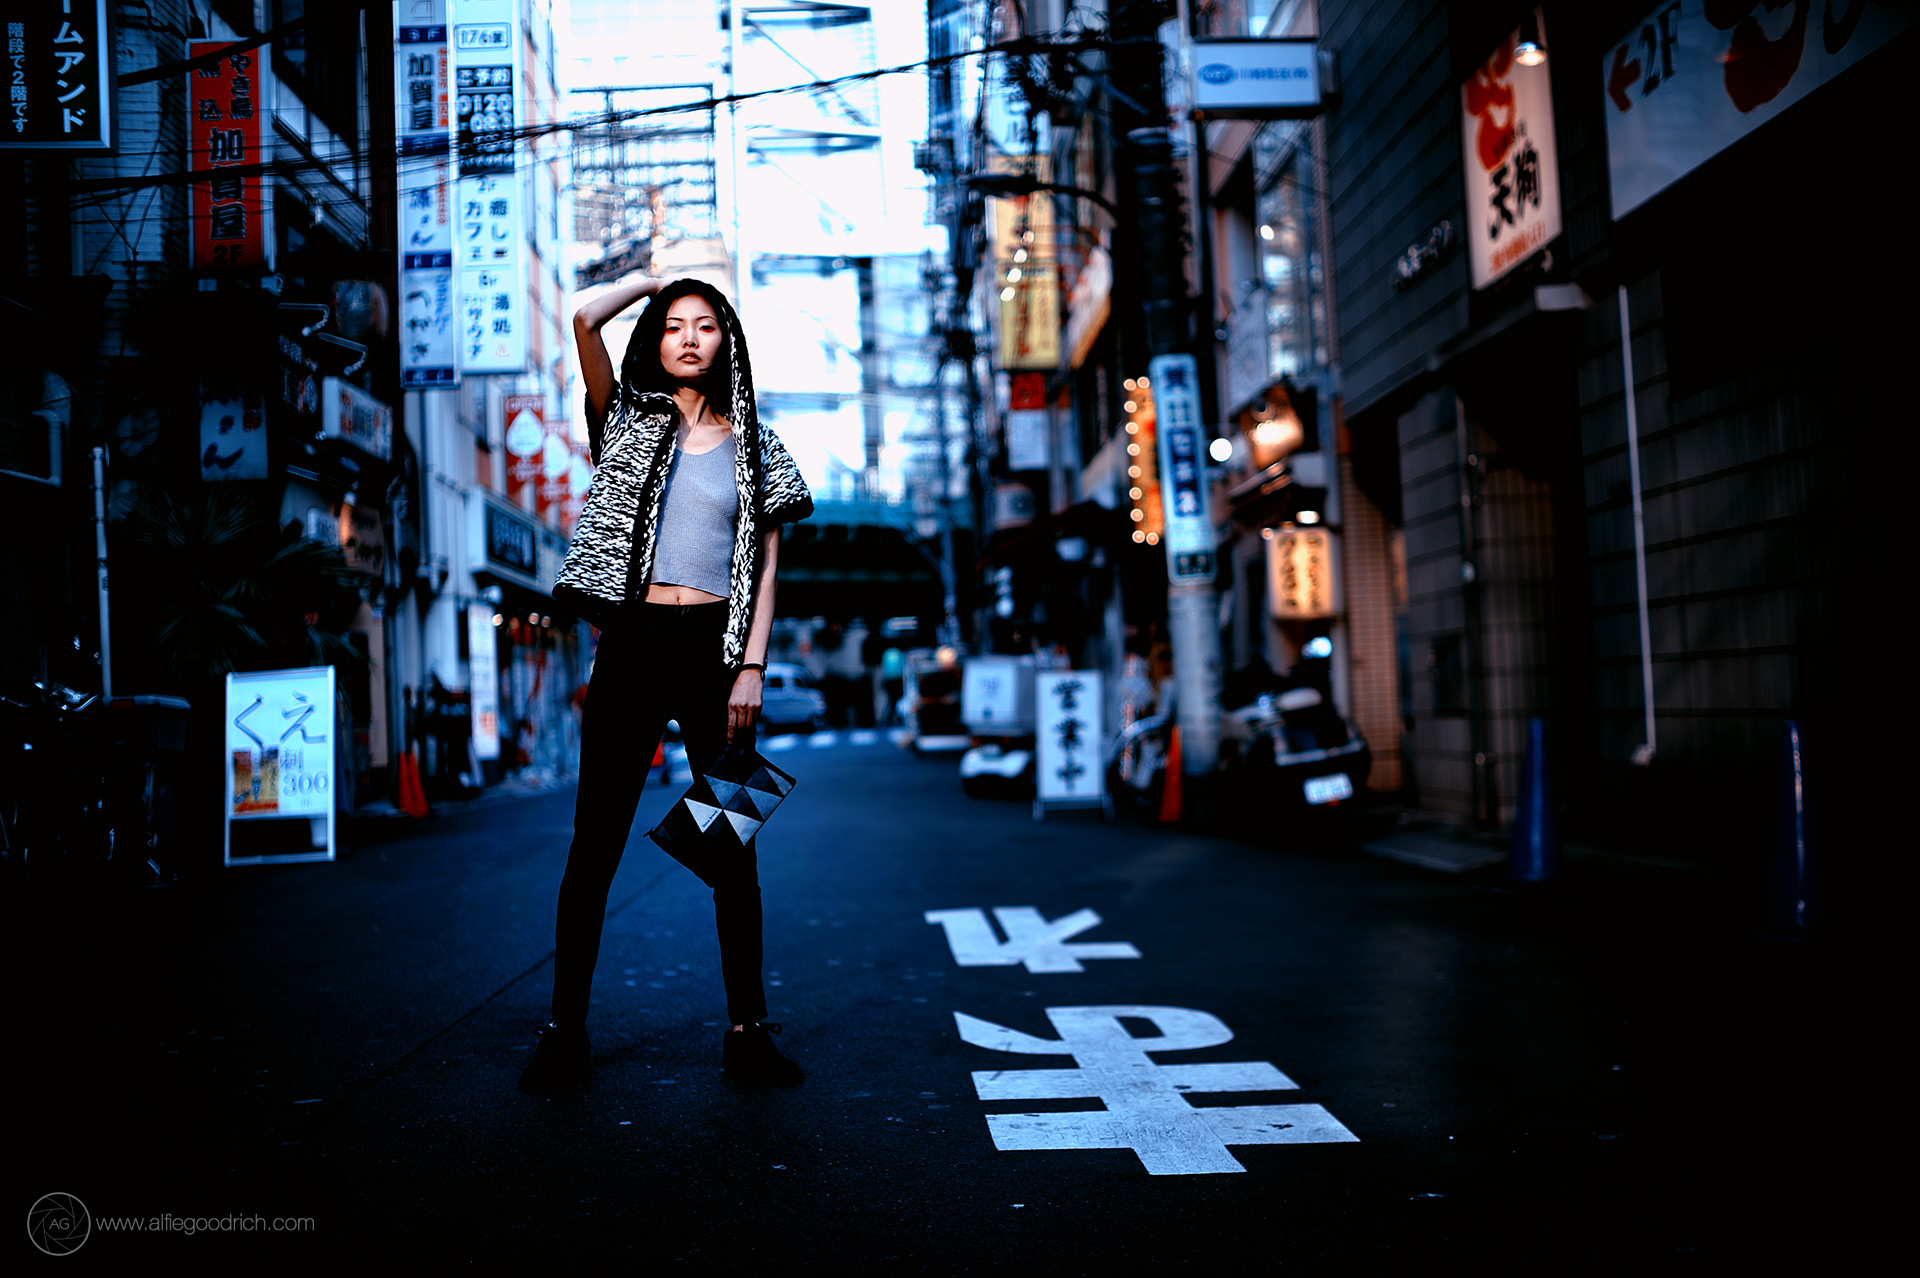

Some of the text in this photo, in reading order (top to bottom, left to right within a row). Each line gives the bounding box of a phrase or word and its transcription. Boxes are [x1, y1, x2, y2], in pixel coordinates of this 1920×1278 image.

[1641, 2, 1683, 95] 2F
[456, 93, 512, 115] 0120
[212, 243, 244, 265] 2F
[234, 690, 328, 751] くえ
[283, 770, 329, 797] 300
